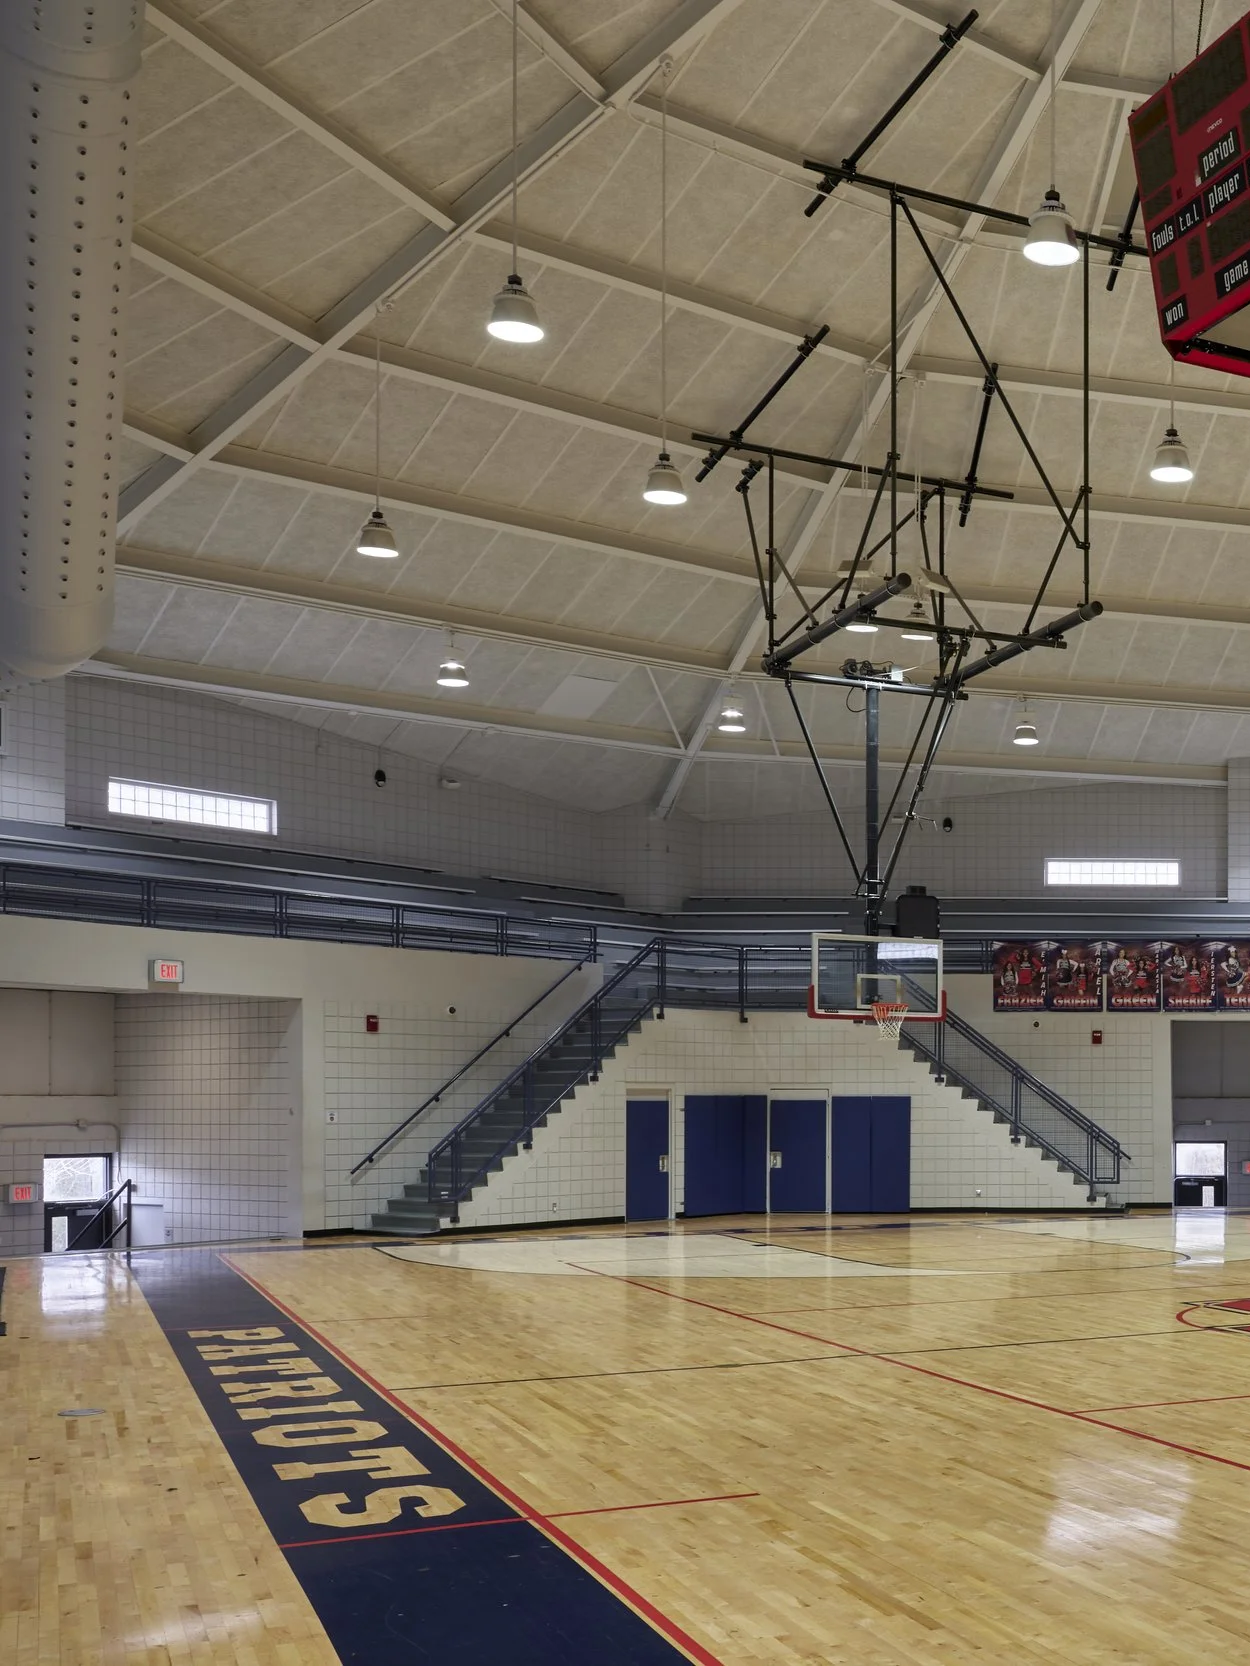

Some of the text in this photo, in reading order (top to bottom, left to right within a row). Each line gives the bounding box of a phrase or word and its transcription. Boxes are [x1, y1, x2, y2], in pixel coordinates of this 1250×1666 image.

[1202, 132, 1235, 177] period
[1152, 223, 1174, 252] fouls
[1208, 172, 1240, 214] player
[1165, 302, 1185, 326] won
[1223, 258, 1249, 292] game
[161, 964, 178, 979] EXIT
[997, 995, 1044, 1006] FRAZIER
[1053, 995, 1098, 1006] GRIFFIN
[1111, 995, 1157, 1006] GREEN
[14, 1187, 31, 1200] EXIT
[188, 1326, 467, 1528] PATRIOTS
